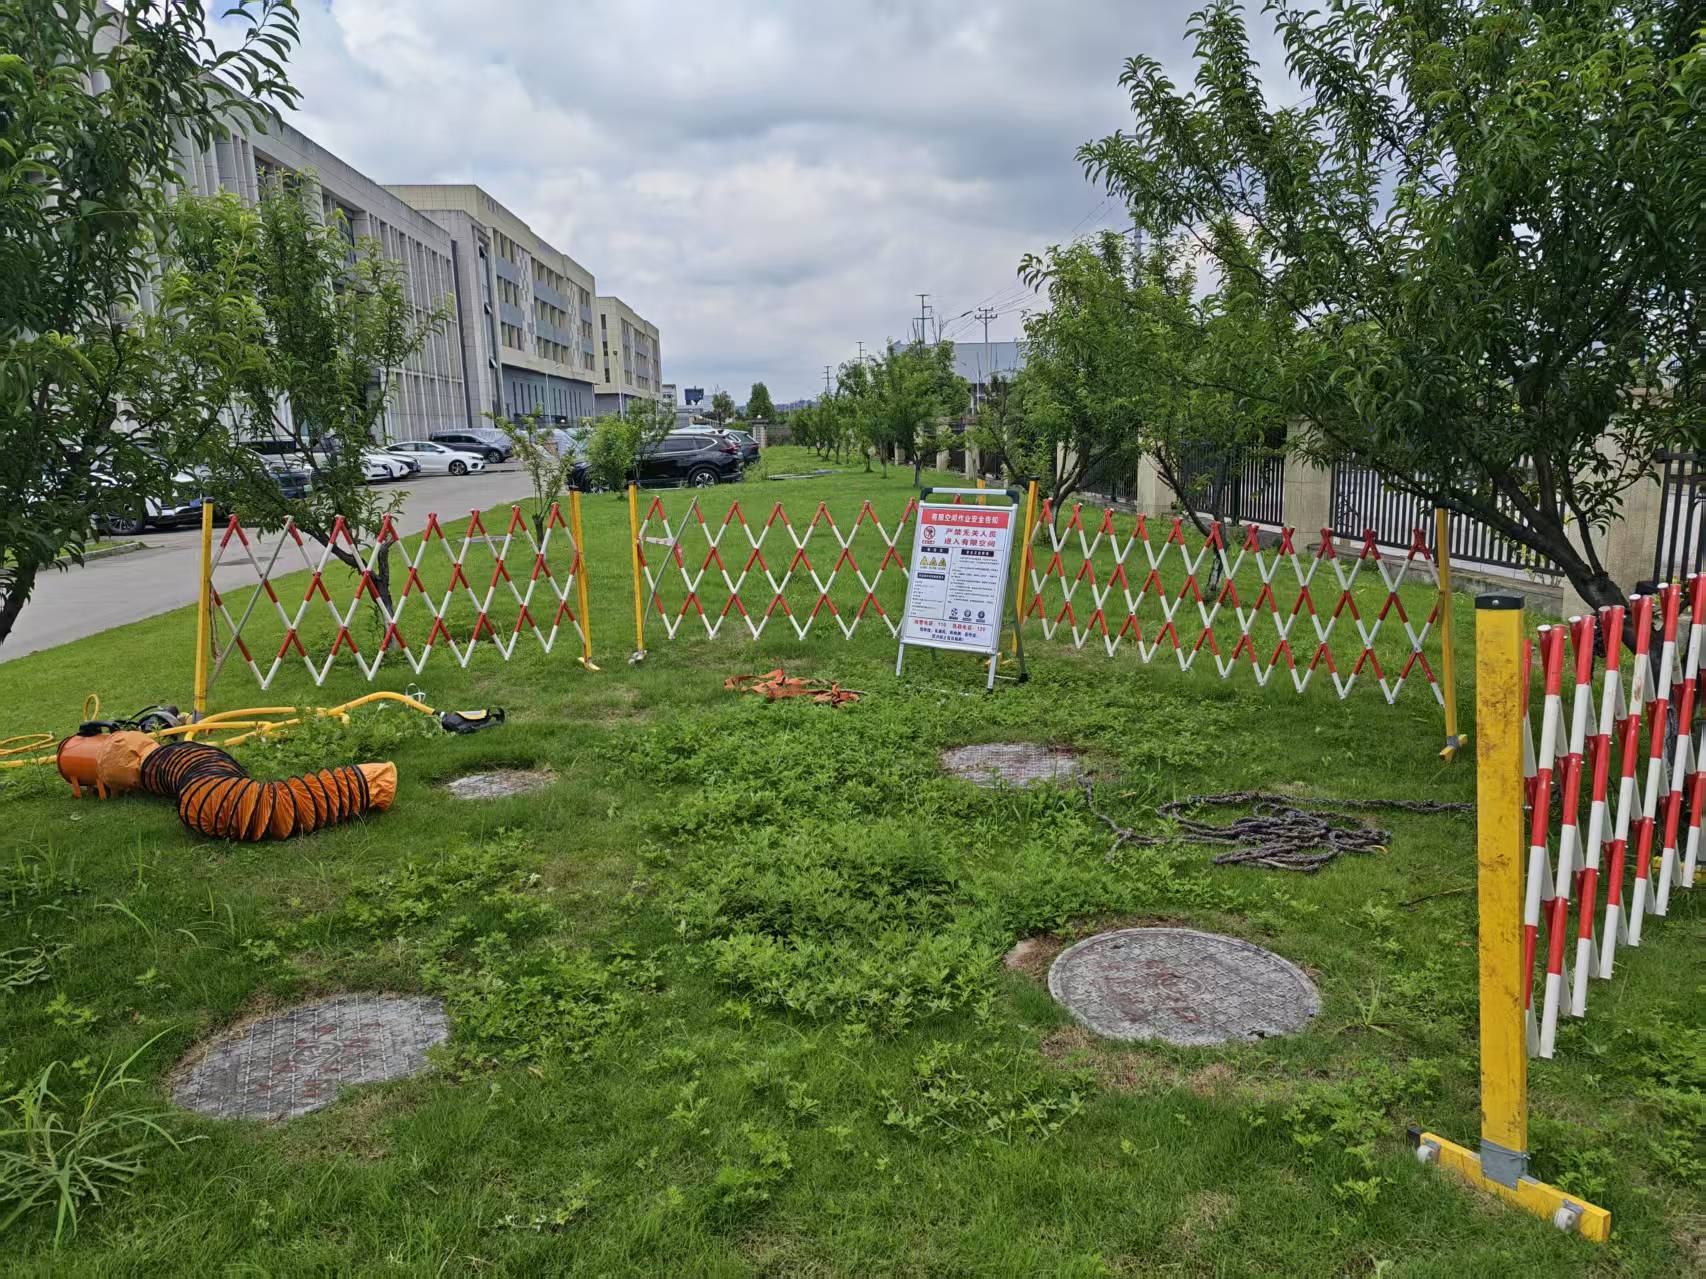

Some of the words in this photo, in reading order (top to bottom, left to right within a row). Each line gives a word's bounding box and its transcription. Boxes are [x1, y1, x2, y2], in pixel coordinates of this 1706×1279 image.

[945, 528, 997, 537] 严禁无关人员
[944, 538, 996, 547] 进入有限空间
